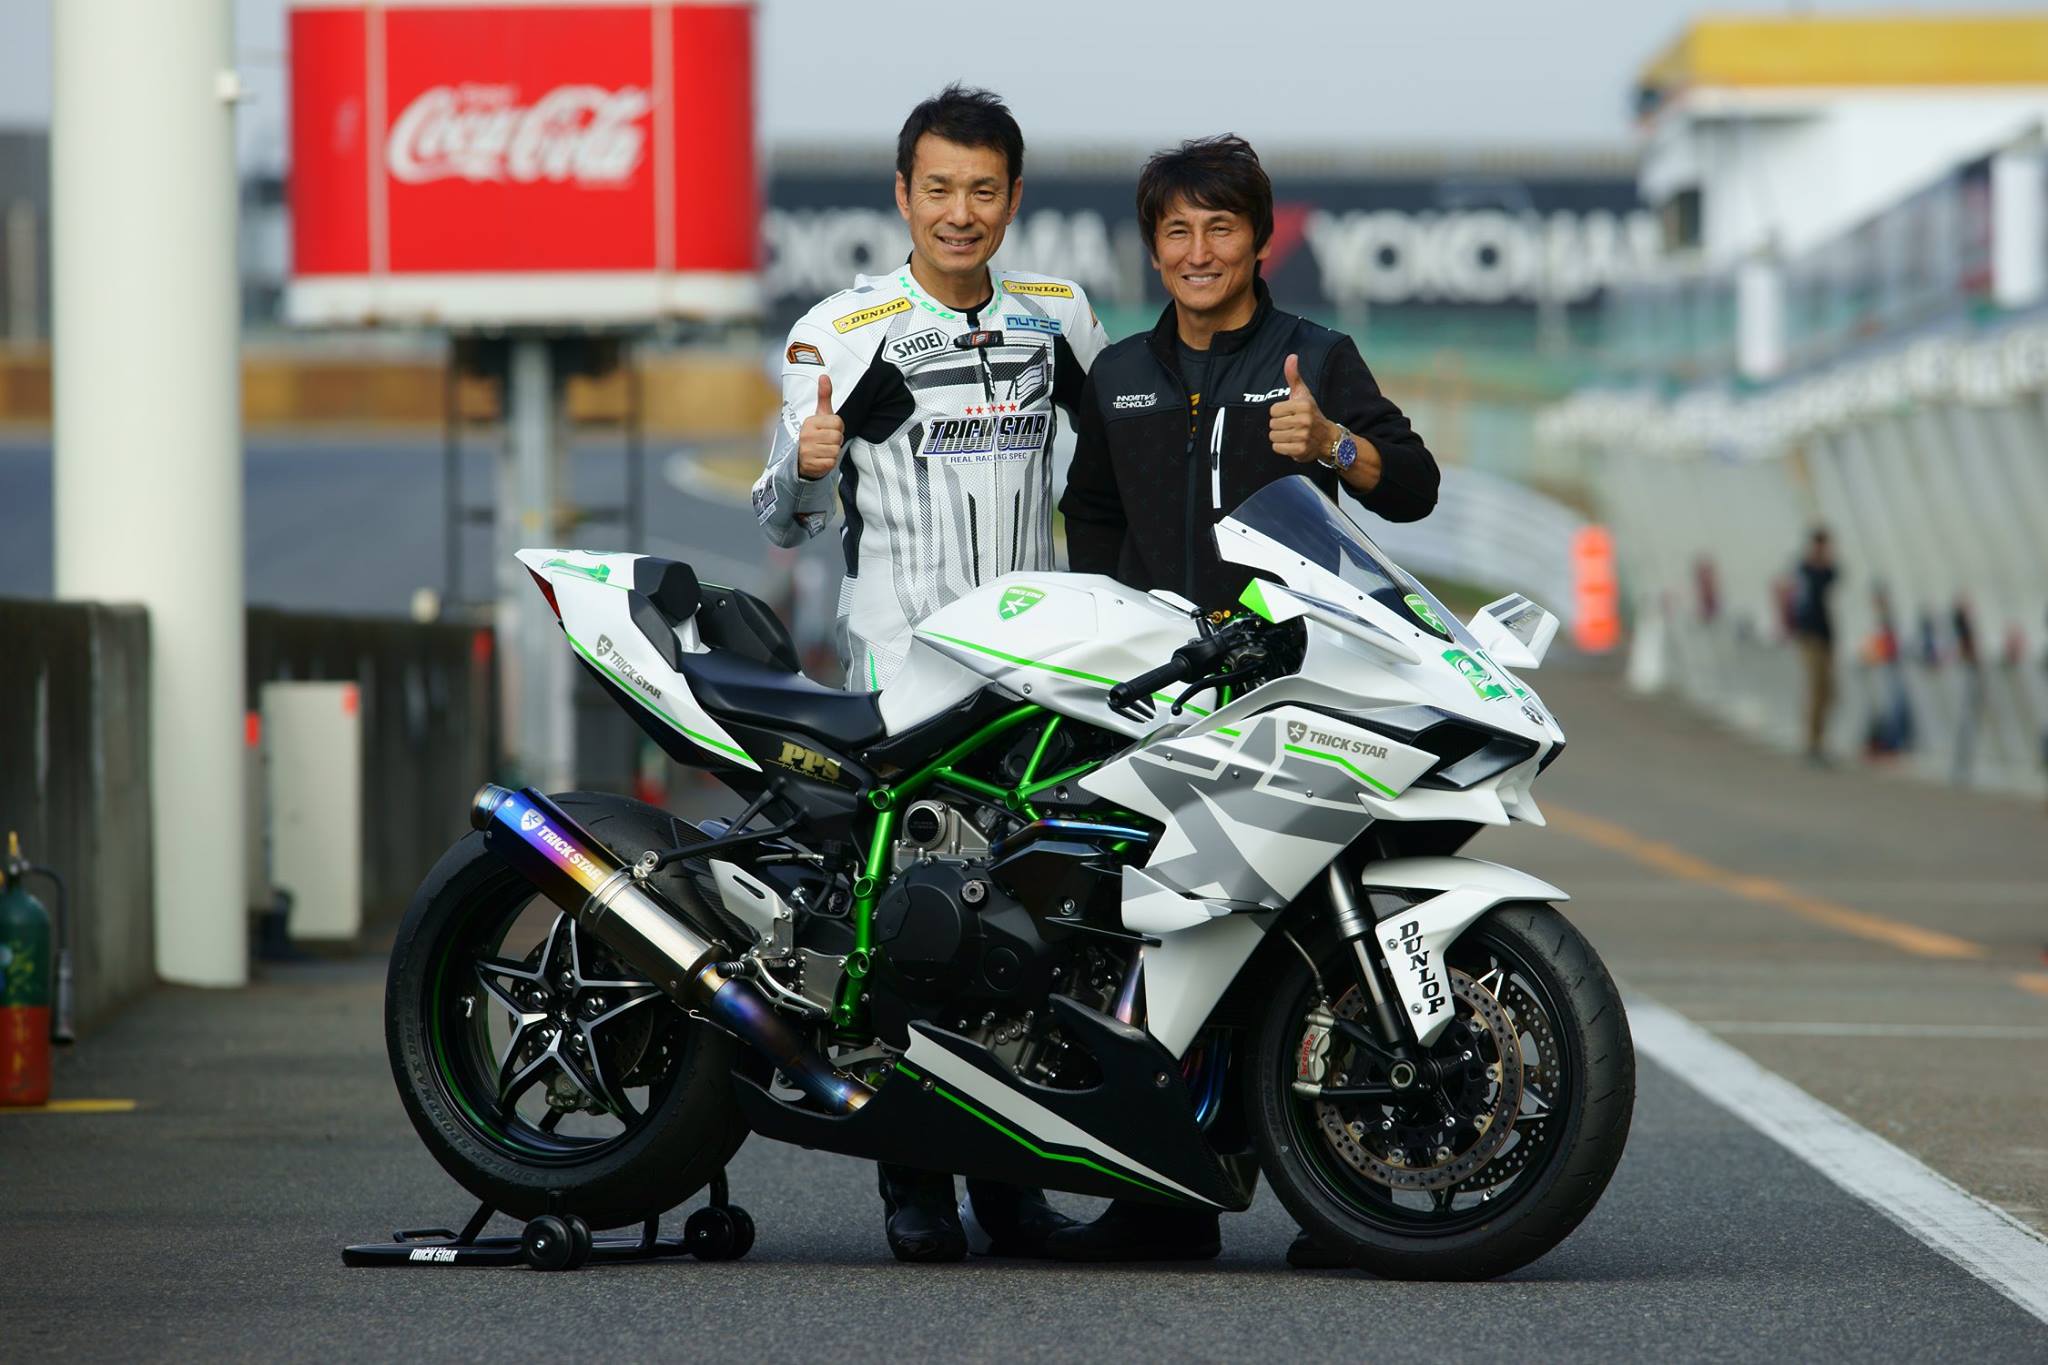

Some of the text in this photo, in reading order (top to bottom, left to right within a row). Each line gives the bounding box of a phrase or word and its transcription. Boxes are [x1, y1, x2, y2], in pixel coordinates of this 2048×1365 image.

[1018, 284, 1068, 294] DUNLOP
[850, 300, 906, 325] DUNLOP
[892, 332, 943, 359] SHOEI
[923, 414, 1047, 455] TRICK STAR
[975, 454, 1007, 462] RACING
[1009, 452, 1027, 460] SPEC
[608, 651, 663, 699] TRICK STAR
[1309, 730, 1389, 759] TRICK STAR
[536, 825, 604, 881] TRICK STAR
[1400, 920, 1446, 1016] DUNLOP
[1300, 1033, 1316, 1076] brembo
[434, 1249, 458, 1262] STAR
